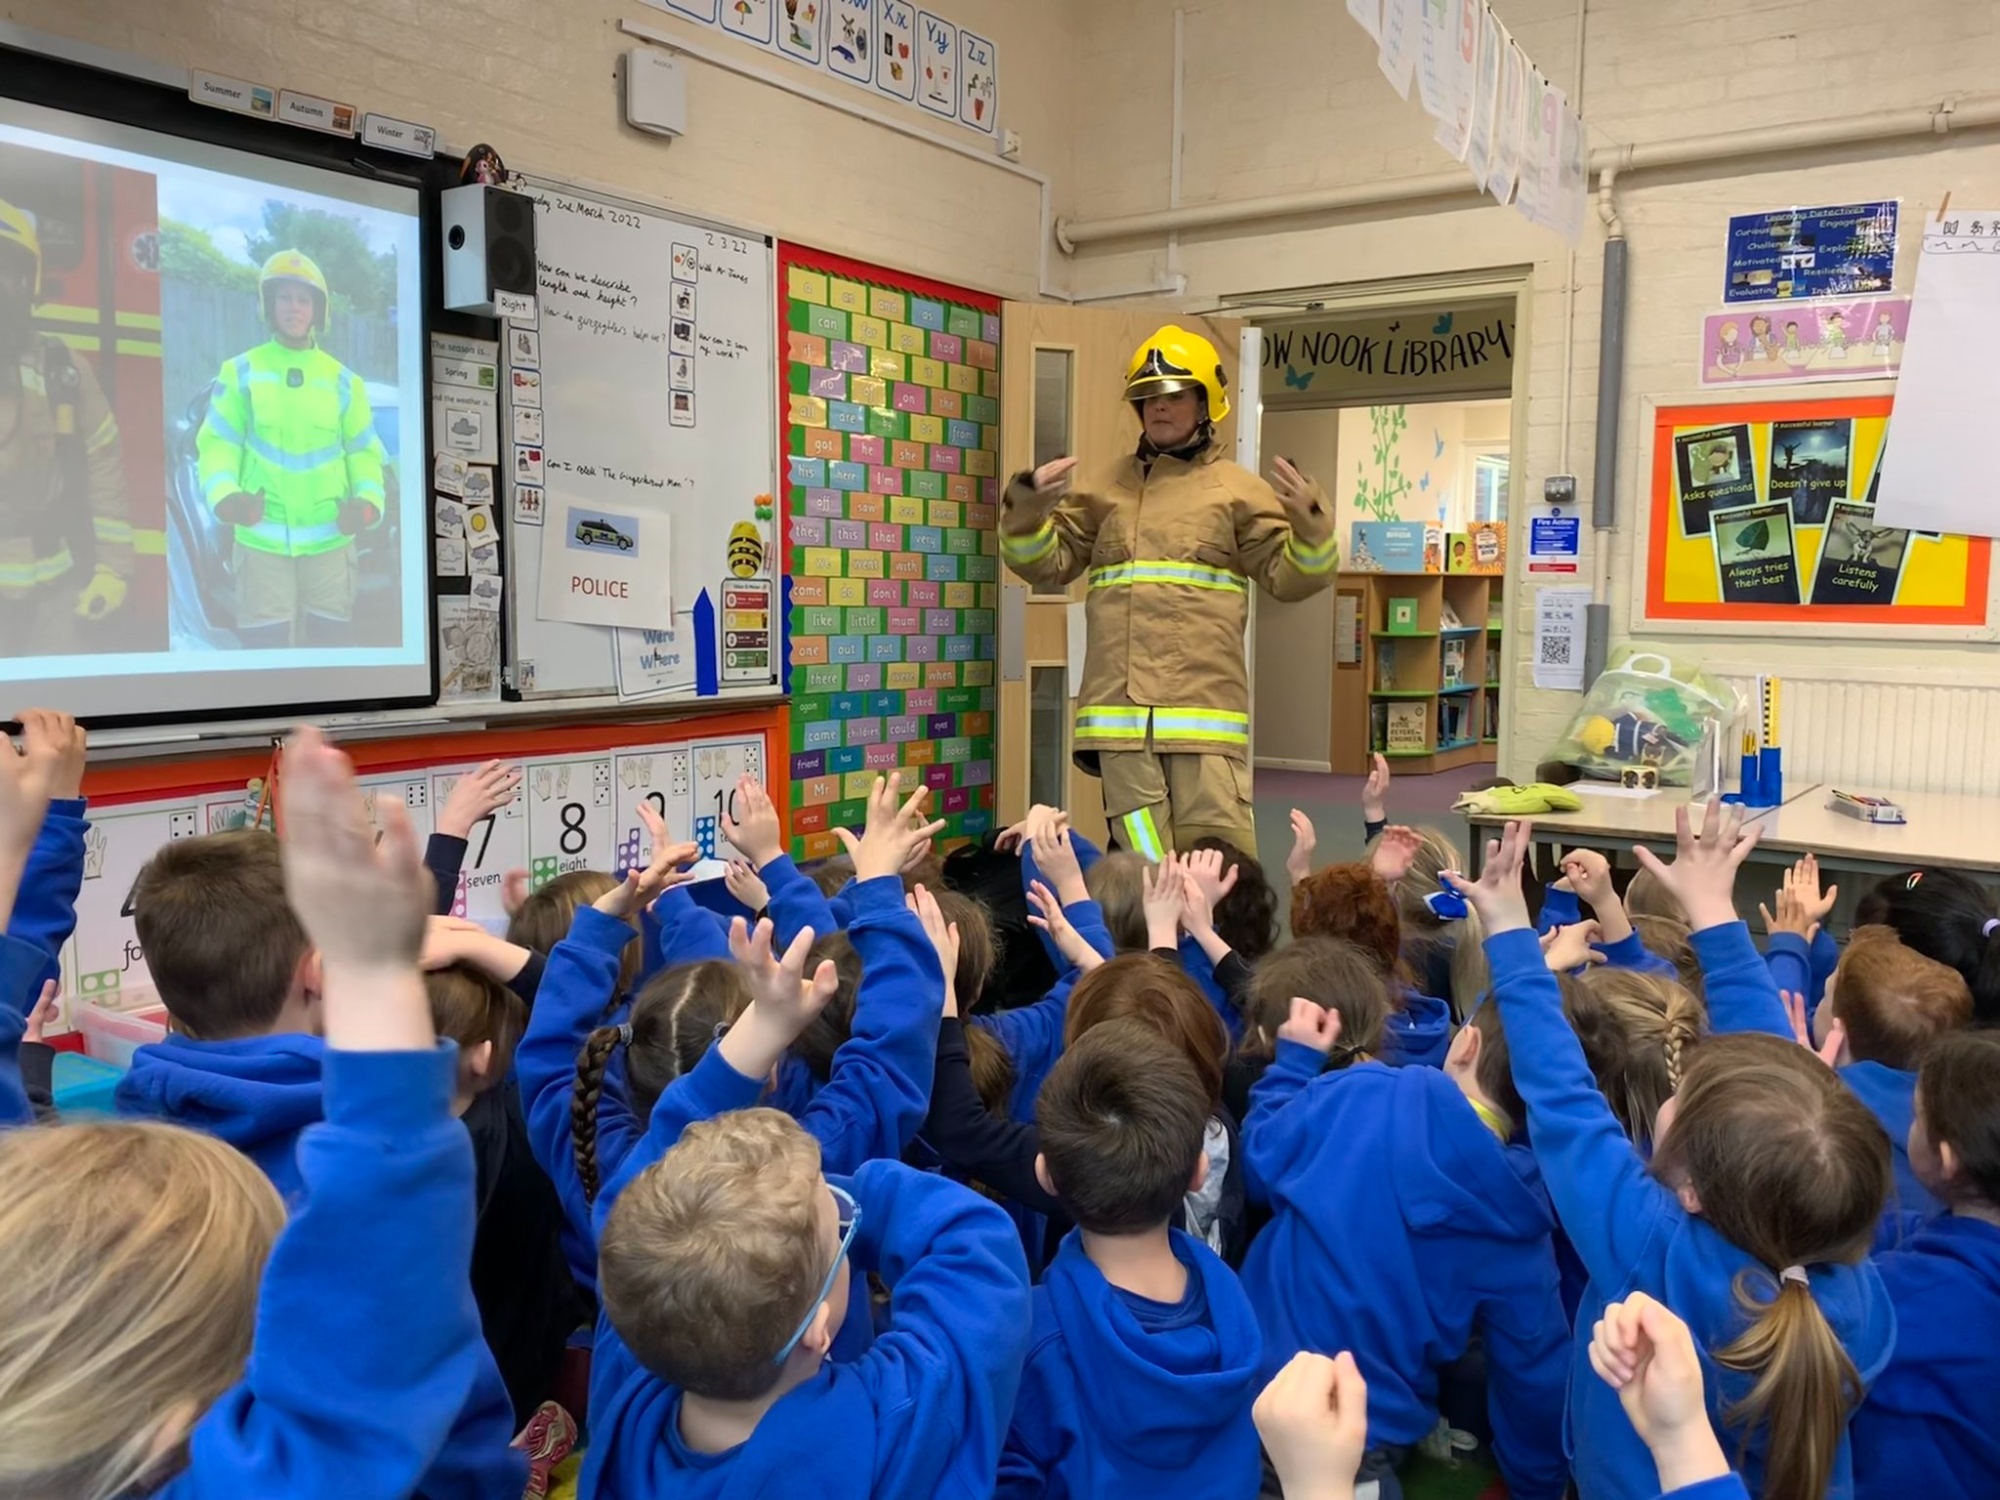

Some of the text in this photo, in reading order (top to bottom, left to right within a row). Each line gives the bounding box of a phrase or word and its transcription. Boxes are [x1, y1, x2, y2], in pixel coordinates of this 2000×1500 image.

[927, 20, 949, 54] Yy
[967, 39, 988, 66] Zz
[203, 81, 242, 99] Summer
[289, 101, 324, 118] Autumn
[377, 125, 403, 139] Winter
[576, 203, 605, 220] March
[609, 210, 641, 229] 2022
[1810, 207, 1865, 219] Detectives
[1733, 256, 1782, 267] Motivated
[539, 276, 568, 293] length
[556, 268, 570, 278] can
[575, 272, 587, 282] we
[591, 275, 631, 293] describe
[1729, 287, 1778, 297] Evaluating
[501, 297, 527, 313] Right
[879, 299, 898, 312] and
[922, 309, 934, 321] as
[818, 317, 837, 330] can
[432, 341, 474, 355] The season
[804, 344, 812, 356] if
[937, 342, 955, 355] had
[1302, 331, 1380, 374] NOOK
[445, 367, 468, 380] Spring
[902, 394, 915, 404] on
[940, 398, 955, 411] the
[800, 404, 815, 417] all
[839, 412, 856, 424] are
[952, 427, 974, 441] from
[815, 438, 833, 453] got
[861, 443, 873, 456] he
[900, 449, 916, 462] she
[936, 451, 955, 465] him
[798, 464, 814, 478] his
[837, 470, 856, 482] here
[877, 473, 894, 486] I'm
[919, 481, 933, 491] me
[1771, 479, 1847, 489] Doesn't give up
[955, 484, 968, 498] my
[1683, 483, 1754, 501] Asks questions
[816, 496, 830, 510] off
[858, 504, 875, 514] saw
[796, 525, 819, 540] they
[838, 529, 858, 541] this
[875, 531, 896, 543] that
[915, 535, 935, 548] very
[952, 537, 970, 547] was
[853, 557, 878, 569] went
[895, 560, 918, 572] with
[1728, 561, 1789, 578] Always tries
[1838, 564, 1877, 578] Listens
[571, 576, 629, 599] POLICE
[1735, 573, 1785, 589] their best
[1832, 576, 1879, 592] carefully
[793, 585, 822, 596] come
[873, 588, 897, 599] don't
[913, 588, 935, 600] have
[812, 613, 832, 626] like
[851, 614, 876, 627] little
[892, 617, 916, 627] mum
[932, 615, 950, 626] dad
[643, 630, 675, 645] Were
[799, 646, 819, 657] one
[838, 644, 855, 654] out
[877, 644, 893, 659] put
[917, 644, 928, 654] so
[948, 643, 971, 653] some
[811, 673, 837, 685] there
[858, 674, 870, 685] up
[929, 670, 953, 681] when
[800, 702, 817, 713] again
[909, 697, 933, 708] asked
[847, 728, 880, 739] children
[890, 721, 916, 735] could
[809, 730, 836, 741] came
[797, 758, 819, 770] friend
[867, 751, 896, 764] house
[814, 784, 829, 796] Mr
[802, 815, 819, 824] once
[560, 803, 587, 855] 8
[466, 873, 502, 888] seven
